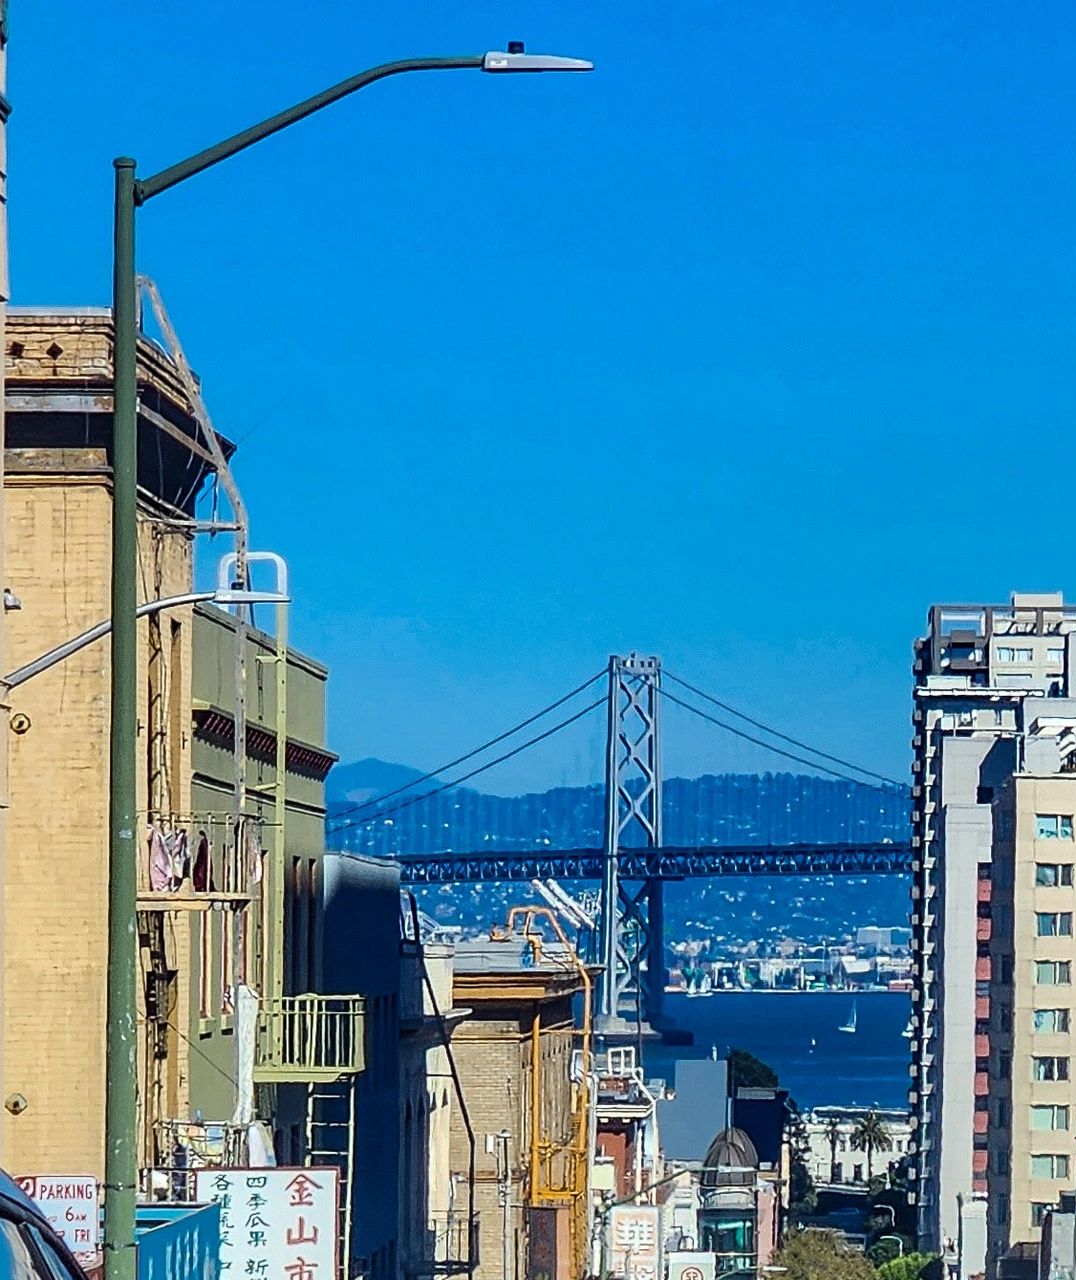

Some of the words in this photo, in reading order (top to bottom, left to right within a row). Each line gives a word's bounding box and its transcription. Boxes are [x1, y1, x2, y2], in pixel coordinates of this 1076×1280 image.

[40, 1184, 93, 1200] PARKING
[245, 1176, 270, 1247] 四季瓜果
[75, 1230, 90, 1242] FRI
